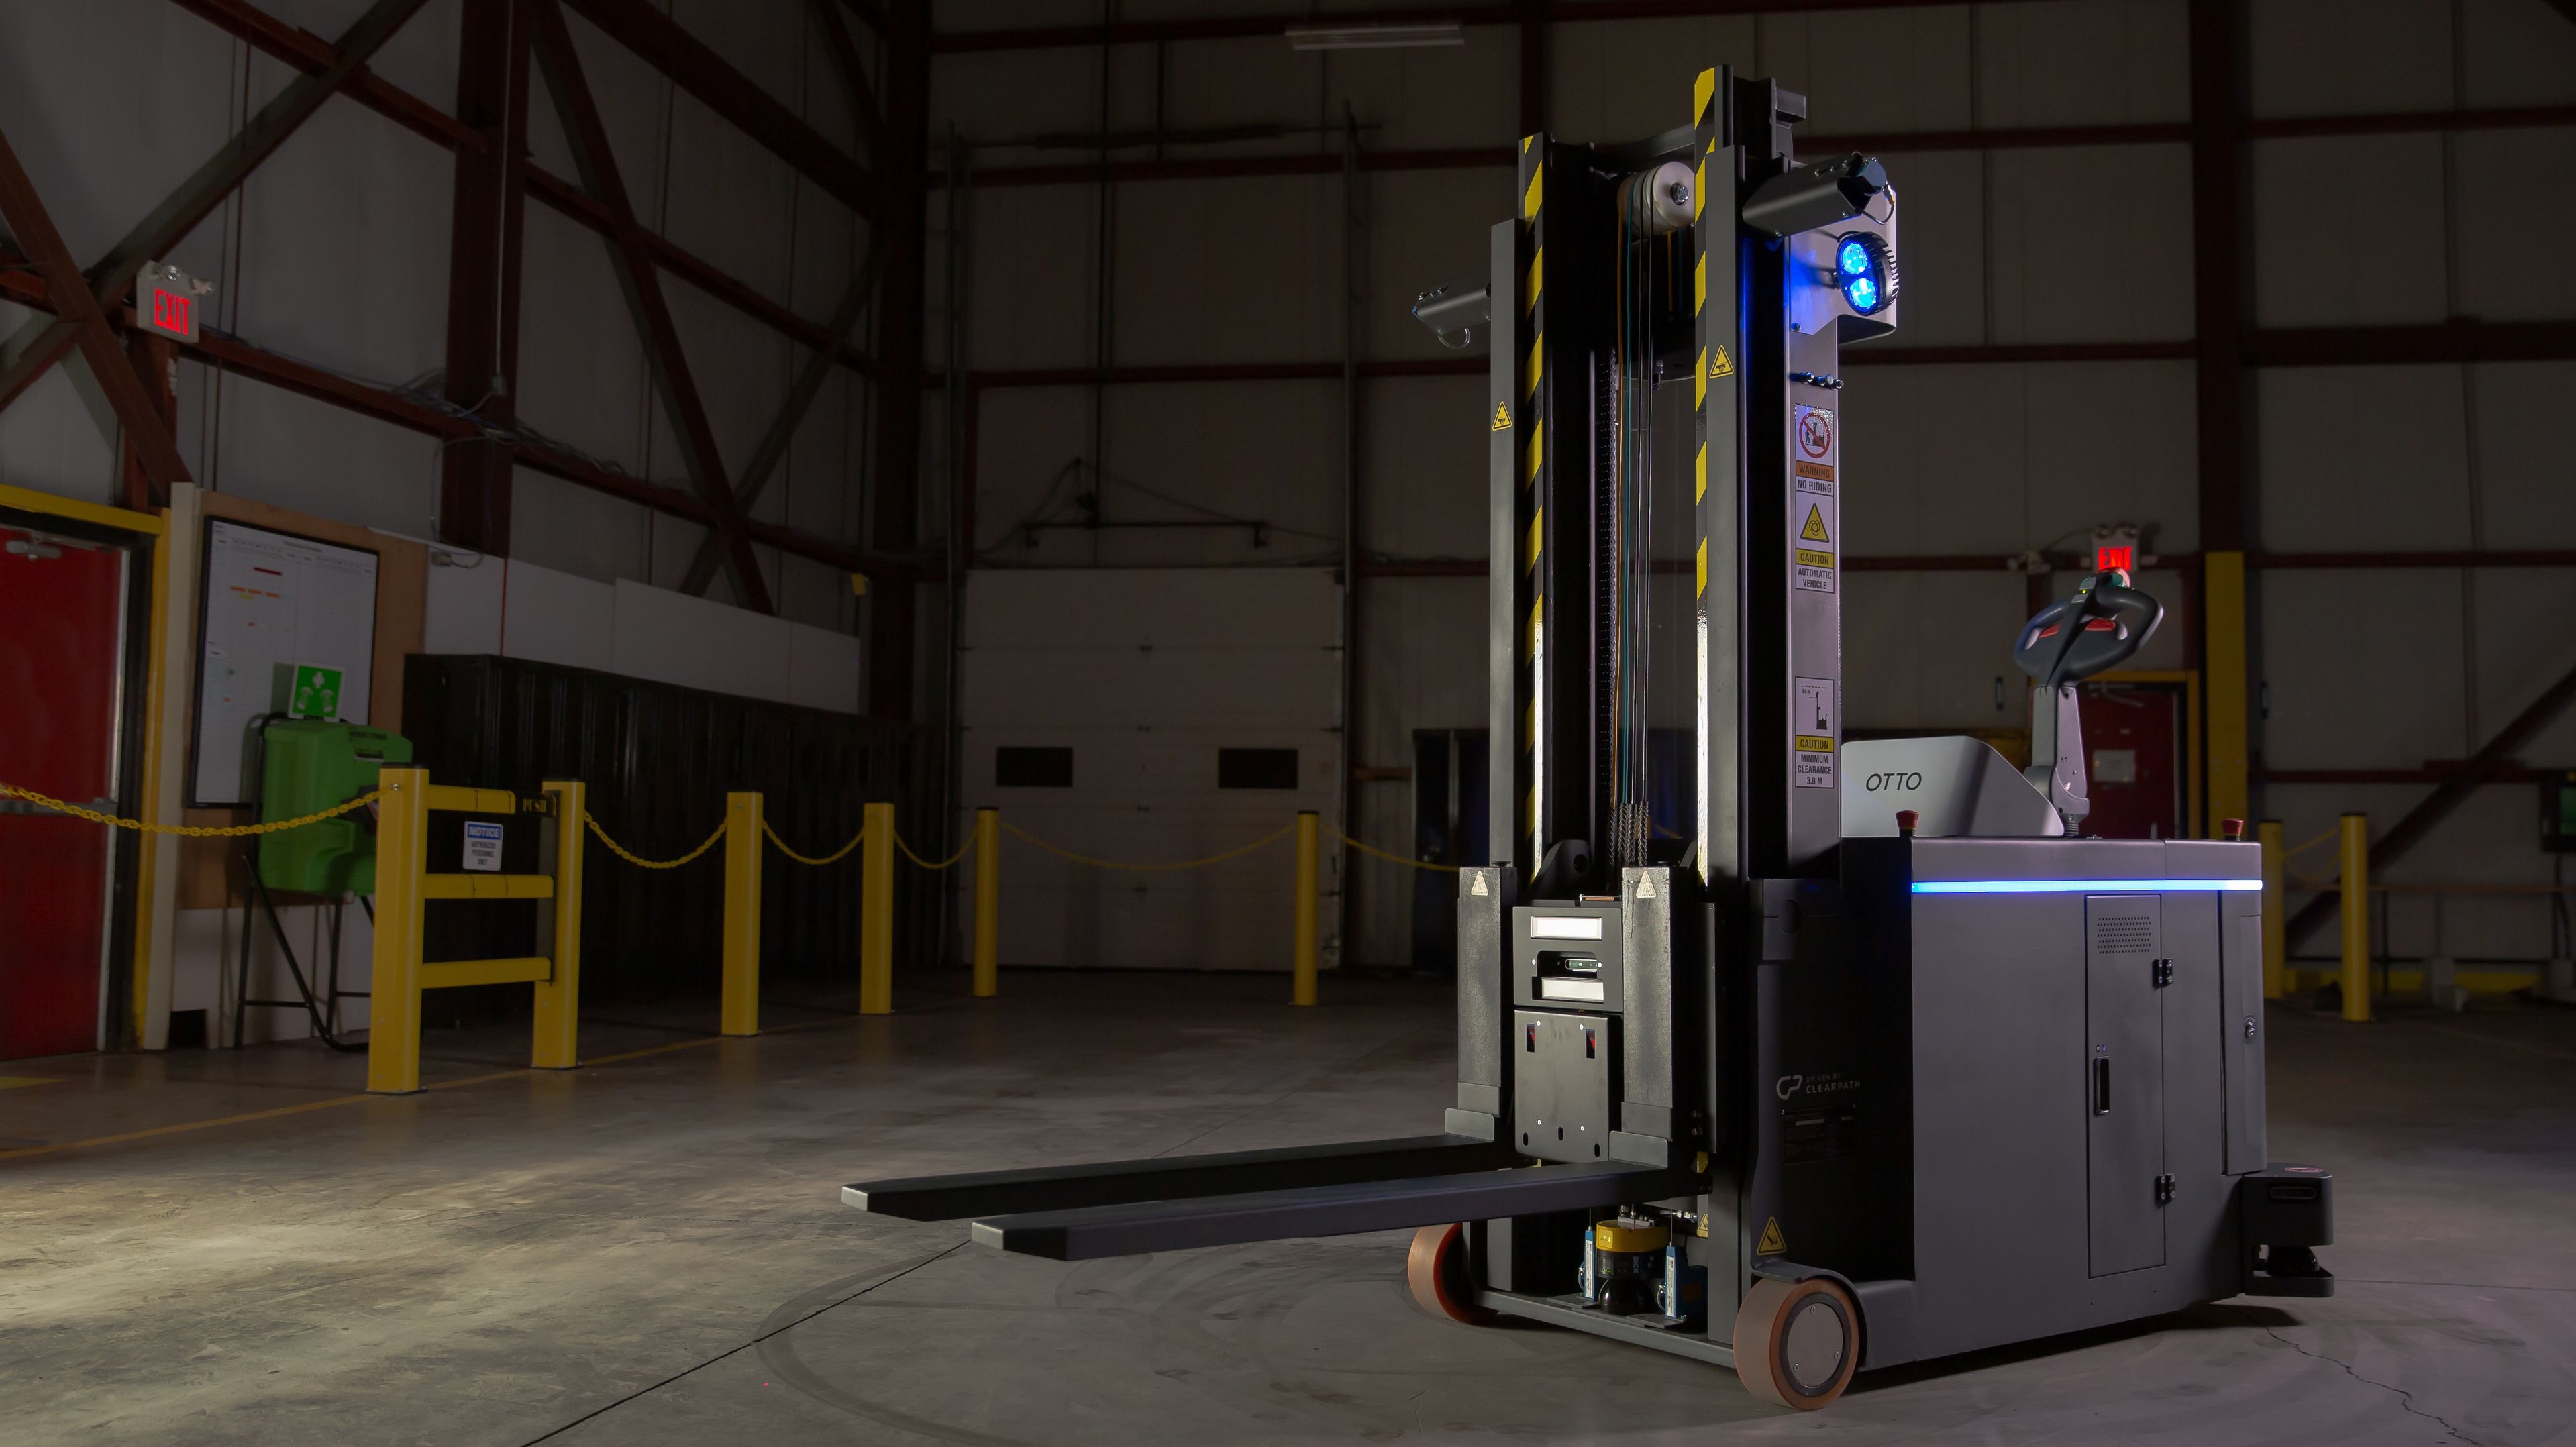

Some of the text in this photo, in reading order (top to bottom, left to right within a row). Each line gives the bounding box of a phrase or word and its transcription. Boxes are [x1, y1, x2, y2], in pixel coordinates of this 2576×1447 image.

[154, 288, 190, 336] EXIT
[1799, 464, 1831, 478] WARNING
[1798, 479, 1832, 493] NO RIDING
[1800, 552, 1829, 565] CAUTION
[1798, 568, 1832, 579] AUTOMATIC
[1803, 579, 1827, 589] VEHICLE
[1800, 739, 1829, 749] CAUTION
[1801, 754, 1828, 763] MINIMUM
[1798, 765, 1832, 774] CLEARANCE
[1806, 776, 1822, 785] 3.8 M
[1866, 772, 1922, 792] OTTO
[470, 826, 501, 839] NOTICE
[1806, 1073, 1831, 1083] DRIVEN
[1806, 1079, 1861, 1094] CLEARPATH
